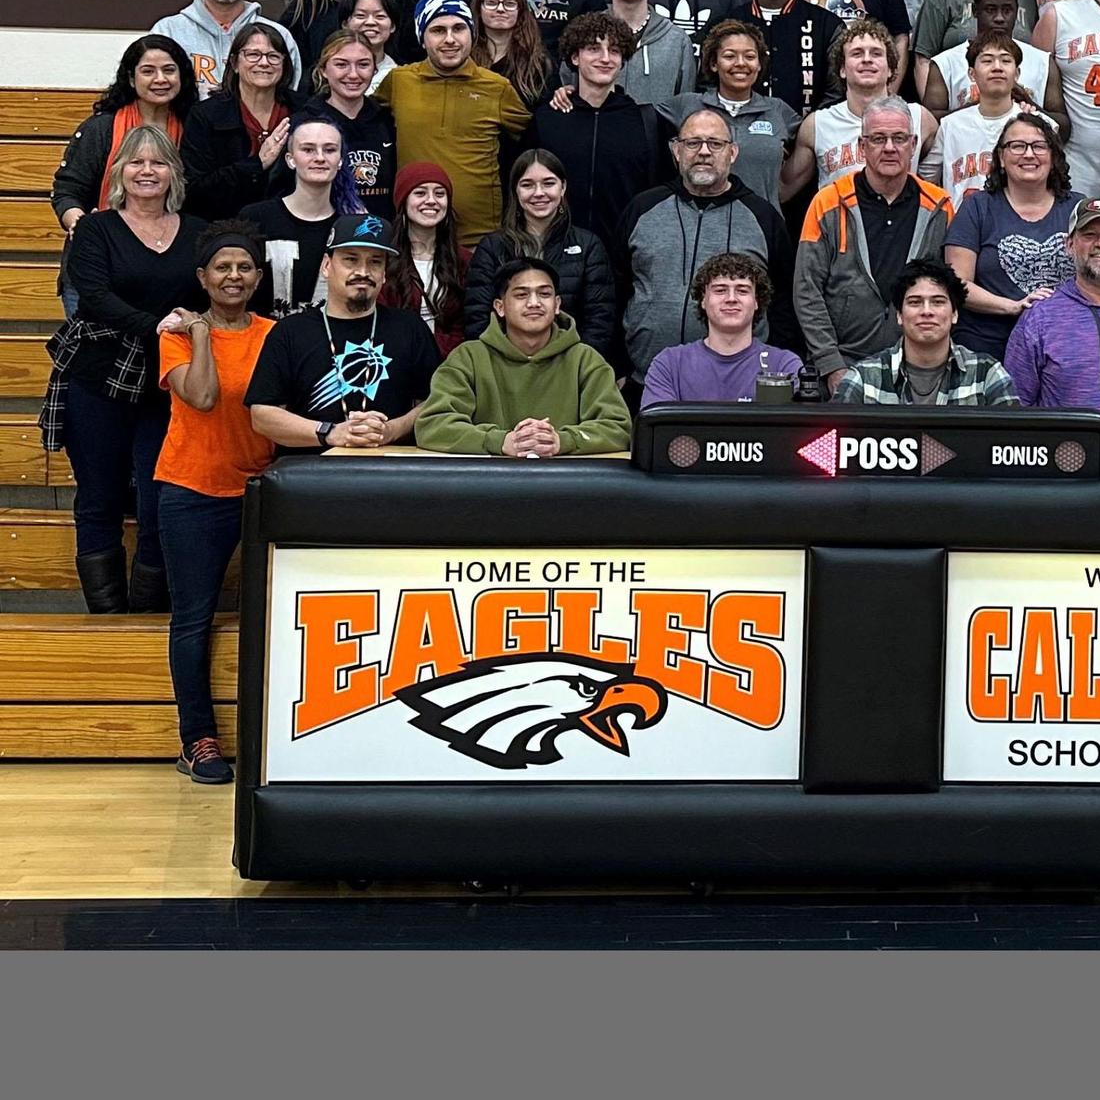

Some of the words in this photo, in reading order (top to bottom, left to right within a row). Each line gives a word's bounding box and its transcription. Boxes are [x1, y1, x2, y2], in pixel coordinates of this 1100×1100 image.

[534, 10, 568, 20] WAR
[348, 150, 381, 167] RIT
[706, 441, 764, 462] BONUS
[839, 437, 918, 470] POSS
[991, 445, 1048, 466] BONUS
[445, 561, 532, 583] HOME
[541, 561, 580, 583] OF
[592, 561, 646, 583] THE
[291, 588, 788, 740] EAGLES
